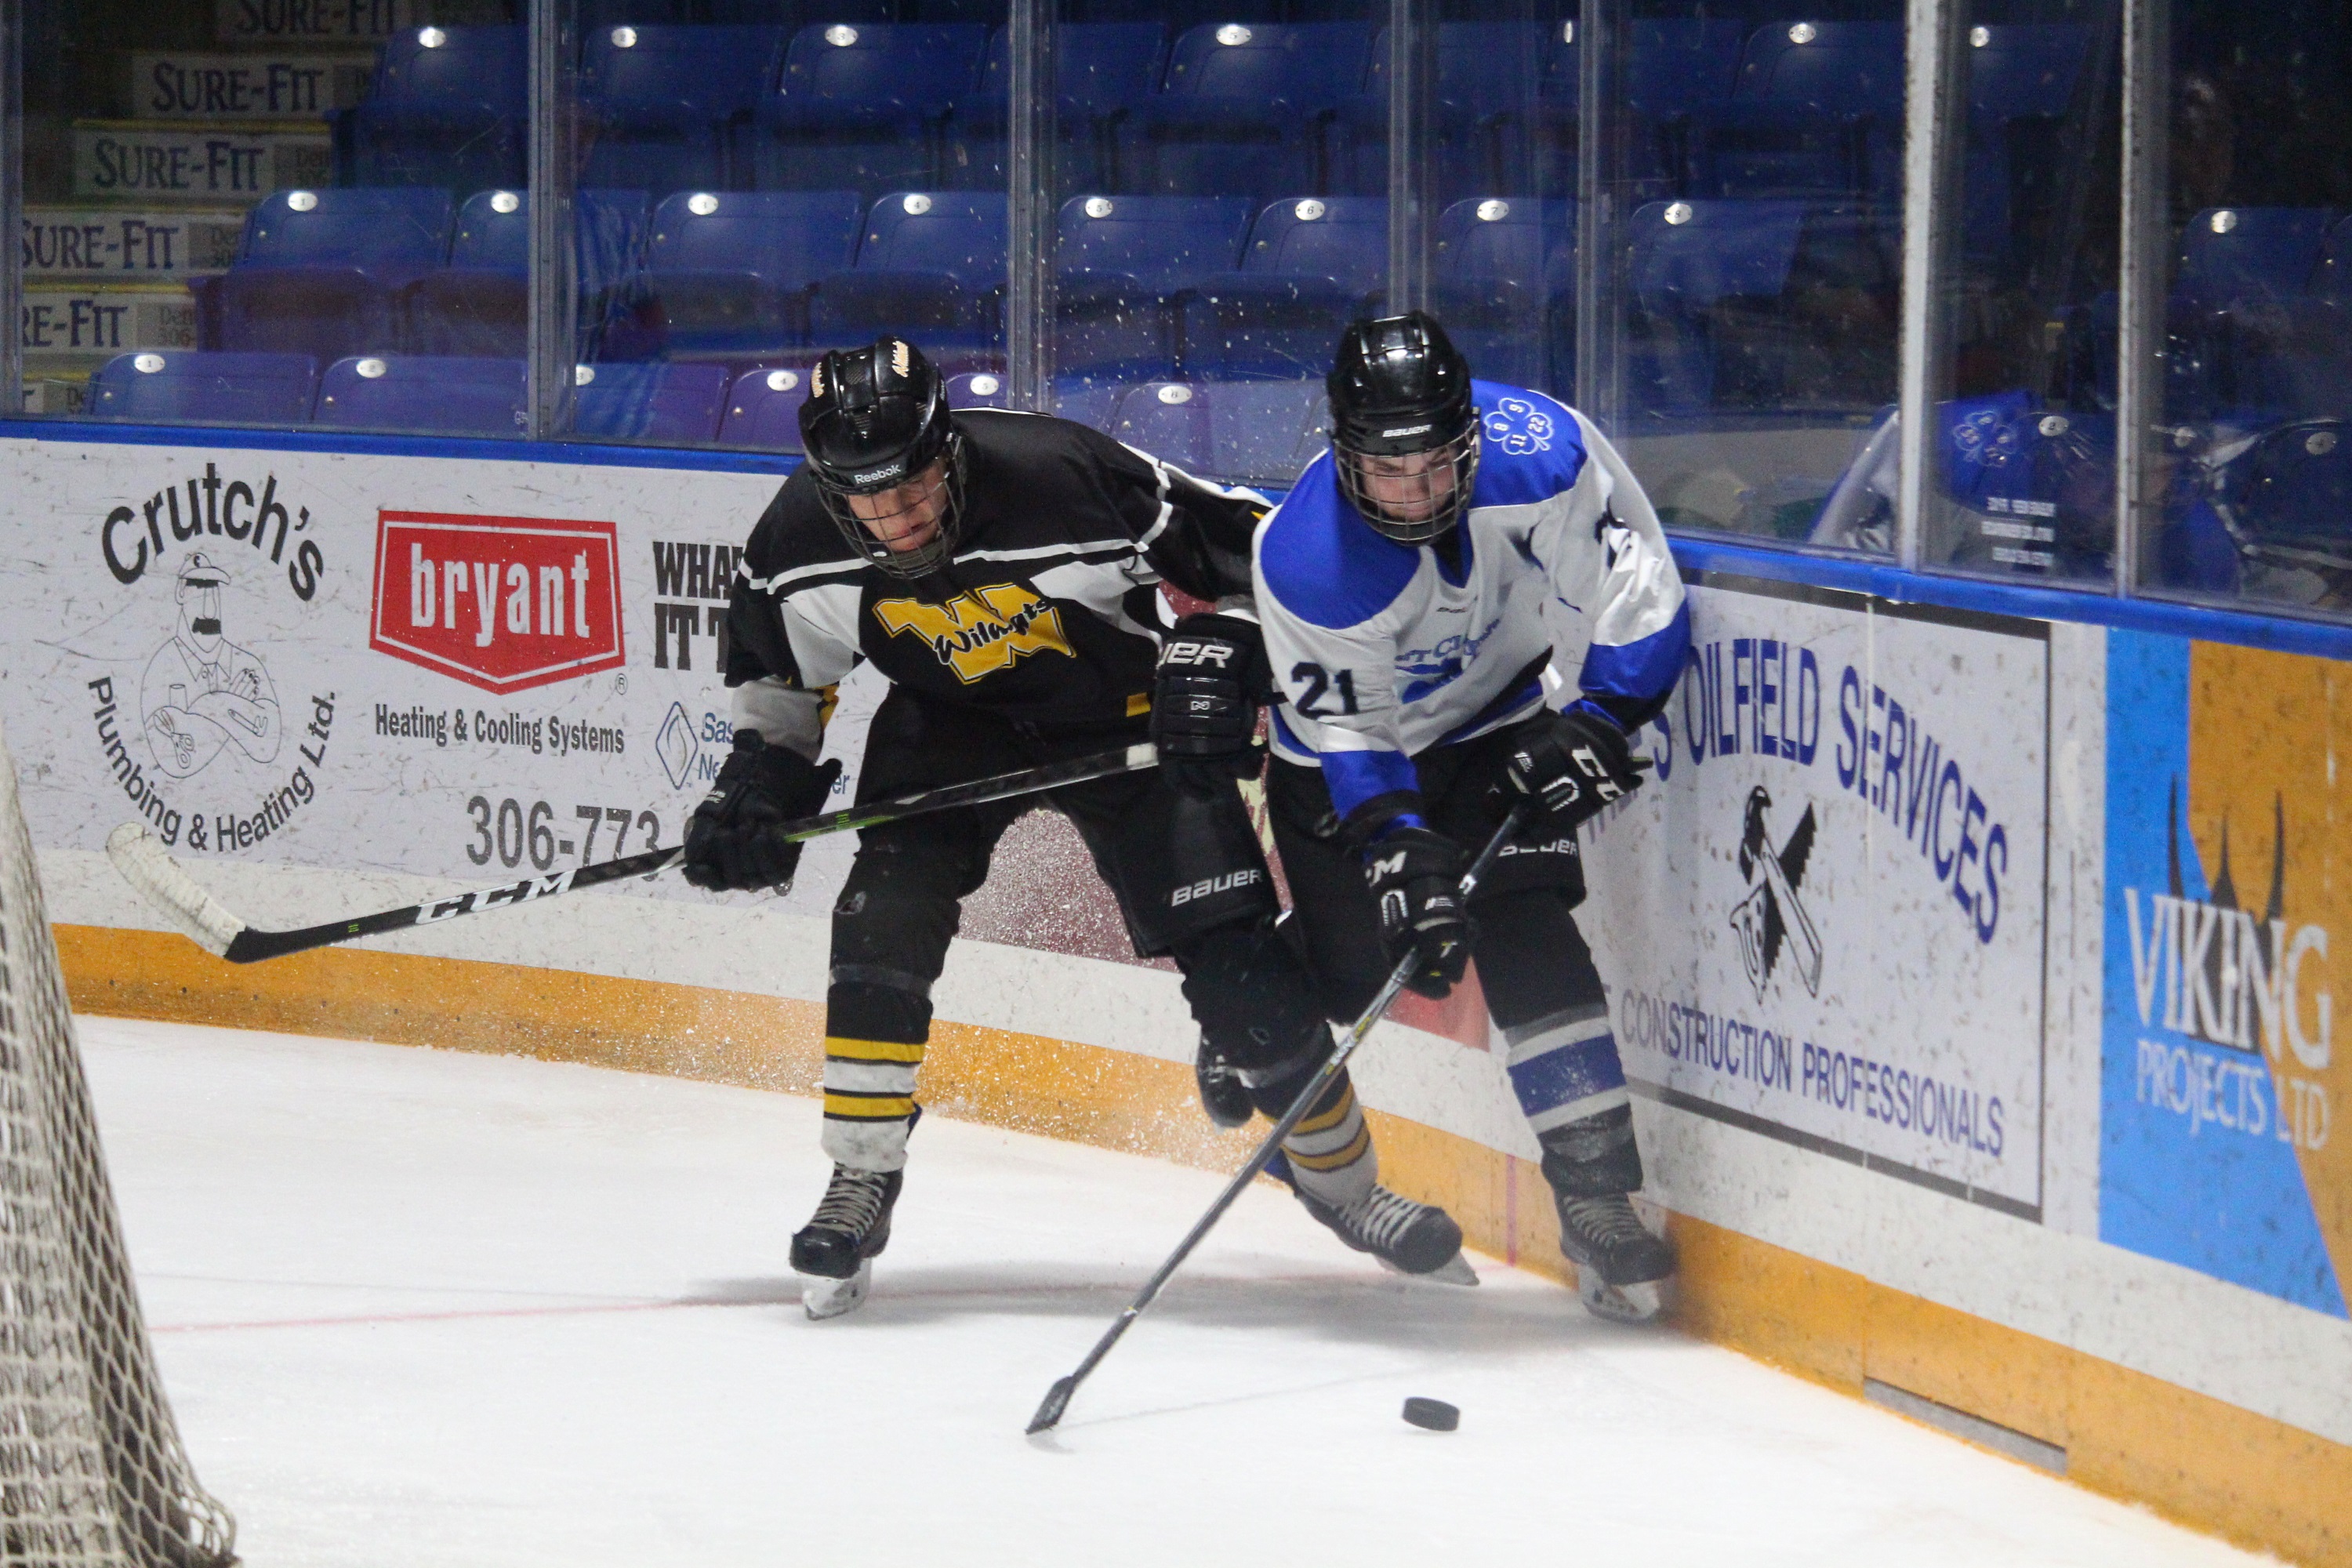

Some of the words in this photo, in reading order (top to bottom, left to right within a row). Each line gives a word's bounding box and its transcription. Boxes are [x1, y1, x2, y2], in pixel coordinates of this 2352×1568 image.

[151, 63, 324, 111] SURE-FIT
[94, 139, 265, 191] SURE-FIT
[853, 463, 902, 485] Reebok
[102, 463, 324, 601] Crutch's
[410, 543, 590, 647] bryant
[655, 603, 699, 671] IT
[376, 703, 448, 746] Heating
[454, 712, 468, 741] &
[474, 710, 543, 754] Cooling
[549, 720, 625, 757] Systems
[1290, 662, 1360, 720] 21
[88, 677, 182, 847] Plumbing
[191, 814, 209, 850] &
[218, 765, 315, 852] Heating
[300, 691, 336, 763] Ltd.
[1682, 638, 1820, 767] OILFIELD
[1836, 665, 2008, 945] SERVICES
[415, 869, 577, 924] CCM
[2124, 887, 2332, 1071] VIKING
[1621, 989, 1792, 1092] CONSTRUCTION
[1802, 1042, 2005, 1158] PROFESSIONALS
[2136, 1039, 2267, 1138] PROJECTS
[2274, 1077, 2330, 1152] LTD
